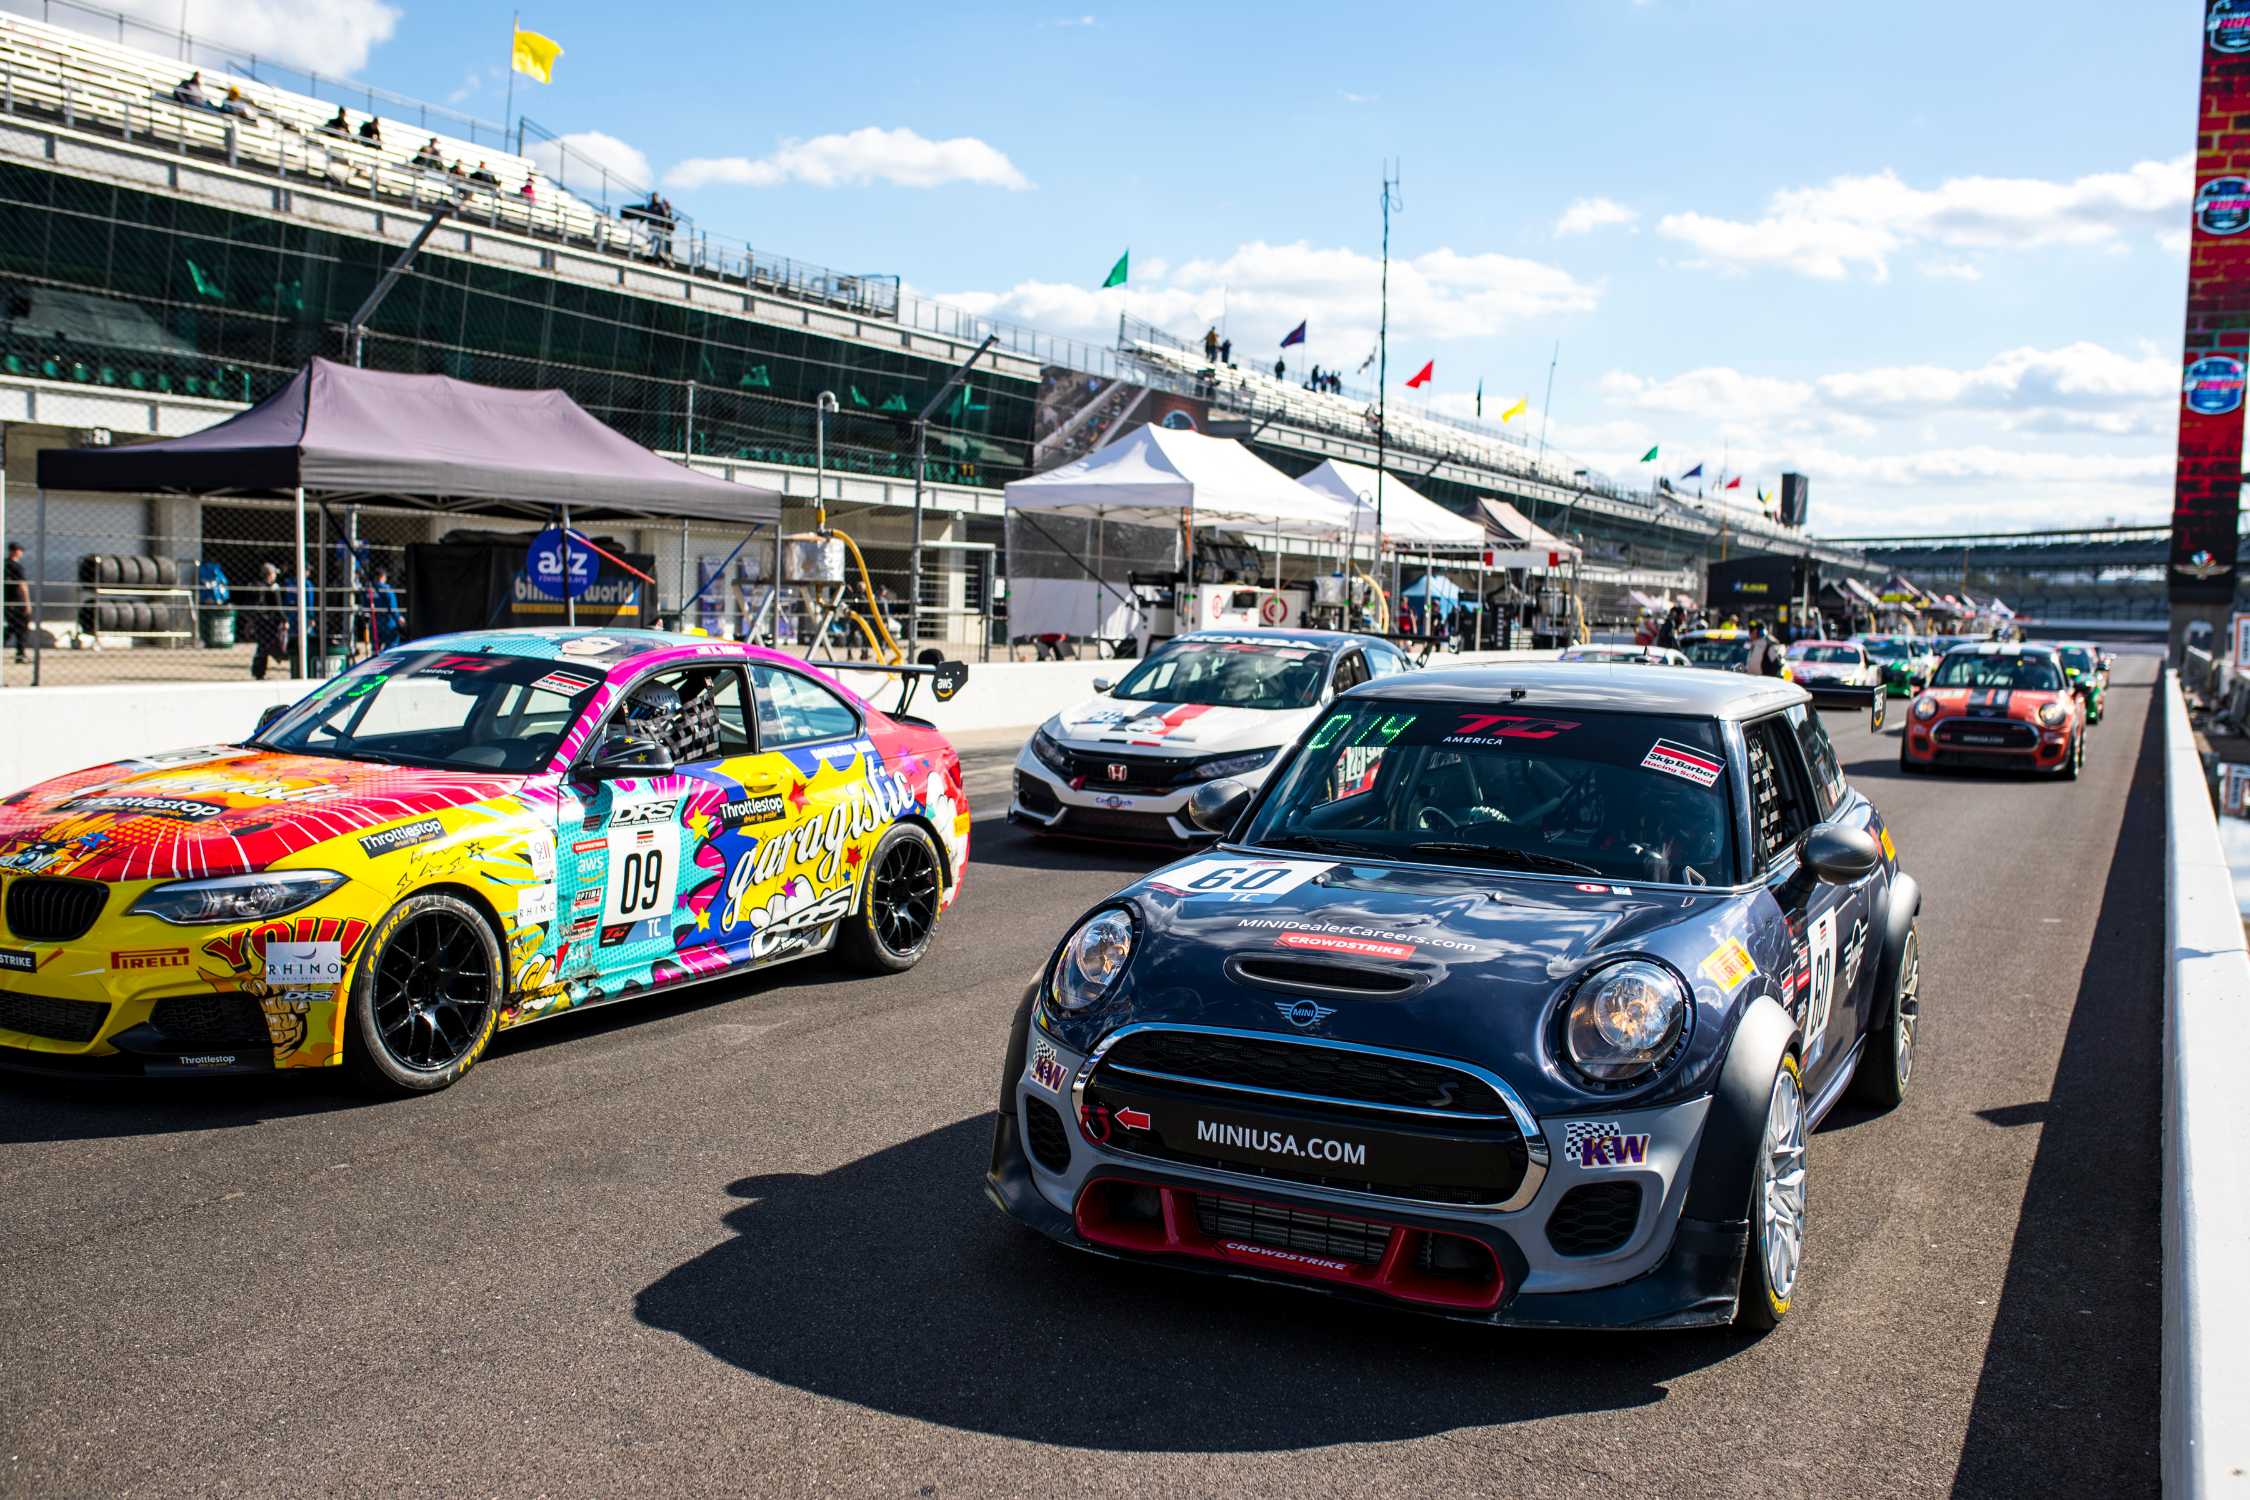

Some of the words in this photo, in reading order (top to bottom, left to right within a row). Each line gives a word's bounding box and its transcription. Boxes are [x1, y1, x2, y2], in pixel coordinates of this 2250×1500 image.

[1183, 635, 1322, 650] HONDA
[937, 678, 953, 690] aws
[1442, 736, 1503, 746] AMERICA
[1643, 759, 1678, 774] Racing
[1680, 769, 1712, 785] School
[1648, 753, 1675, 765] Skip
[1675, 760, 1716, 779] Barber
[62, 796, 222, 818] Throttlestop
[719, 797, 784, 819] Throttlestop
[359, 820, 442, 850] Throttlestop
[578, 856, 605, 873] aws
[620, 849, 662, 915] 09
[1187, 867, 1293, 890] 60
[648, 918, 662, 938] TC
[1237, 918, 1477, 954] MINIDealerCareers.com
[1287, 935, 1405, 956] CROWDSTRIKE
[110, 948, 190, 970] PIRELLI
[268, 962, 339, 975] RHINO
[1292, 1007, 1315, 1017] MINI
[179, 1054, 236, 1066] Throttlestop
[1033, 1055, 1068, 1092] KW
[1197, 1120, 1366, 1166] MINIUSA.COM
[1580, 1135, 1649, 1168] KW
[1225, 1242, 1348, 1270] CROWDSTRIKE
